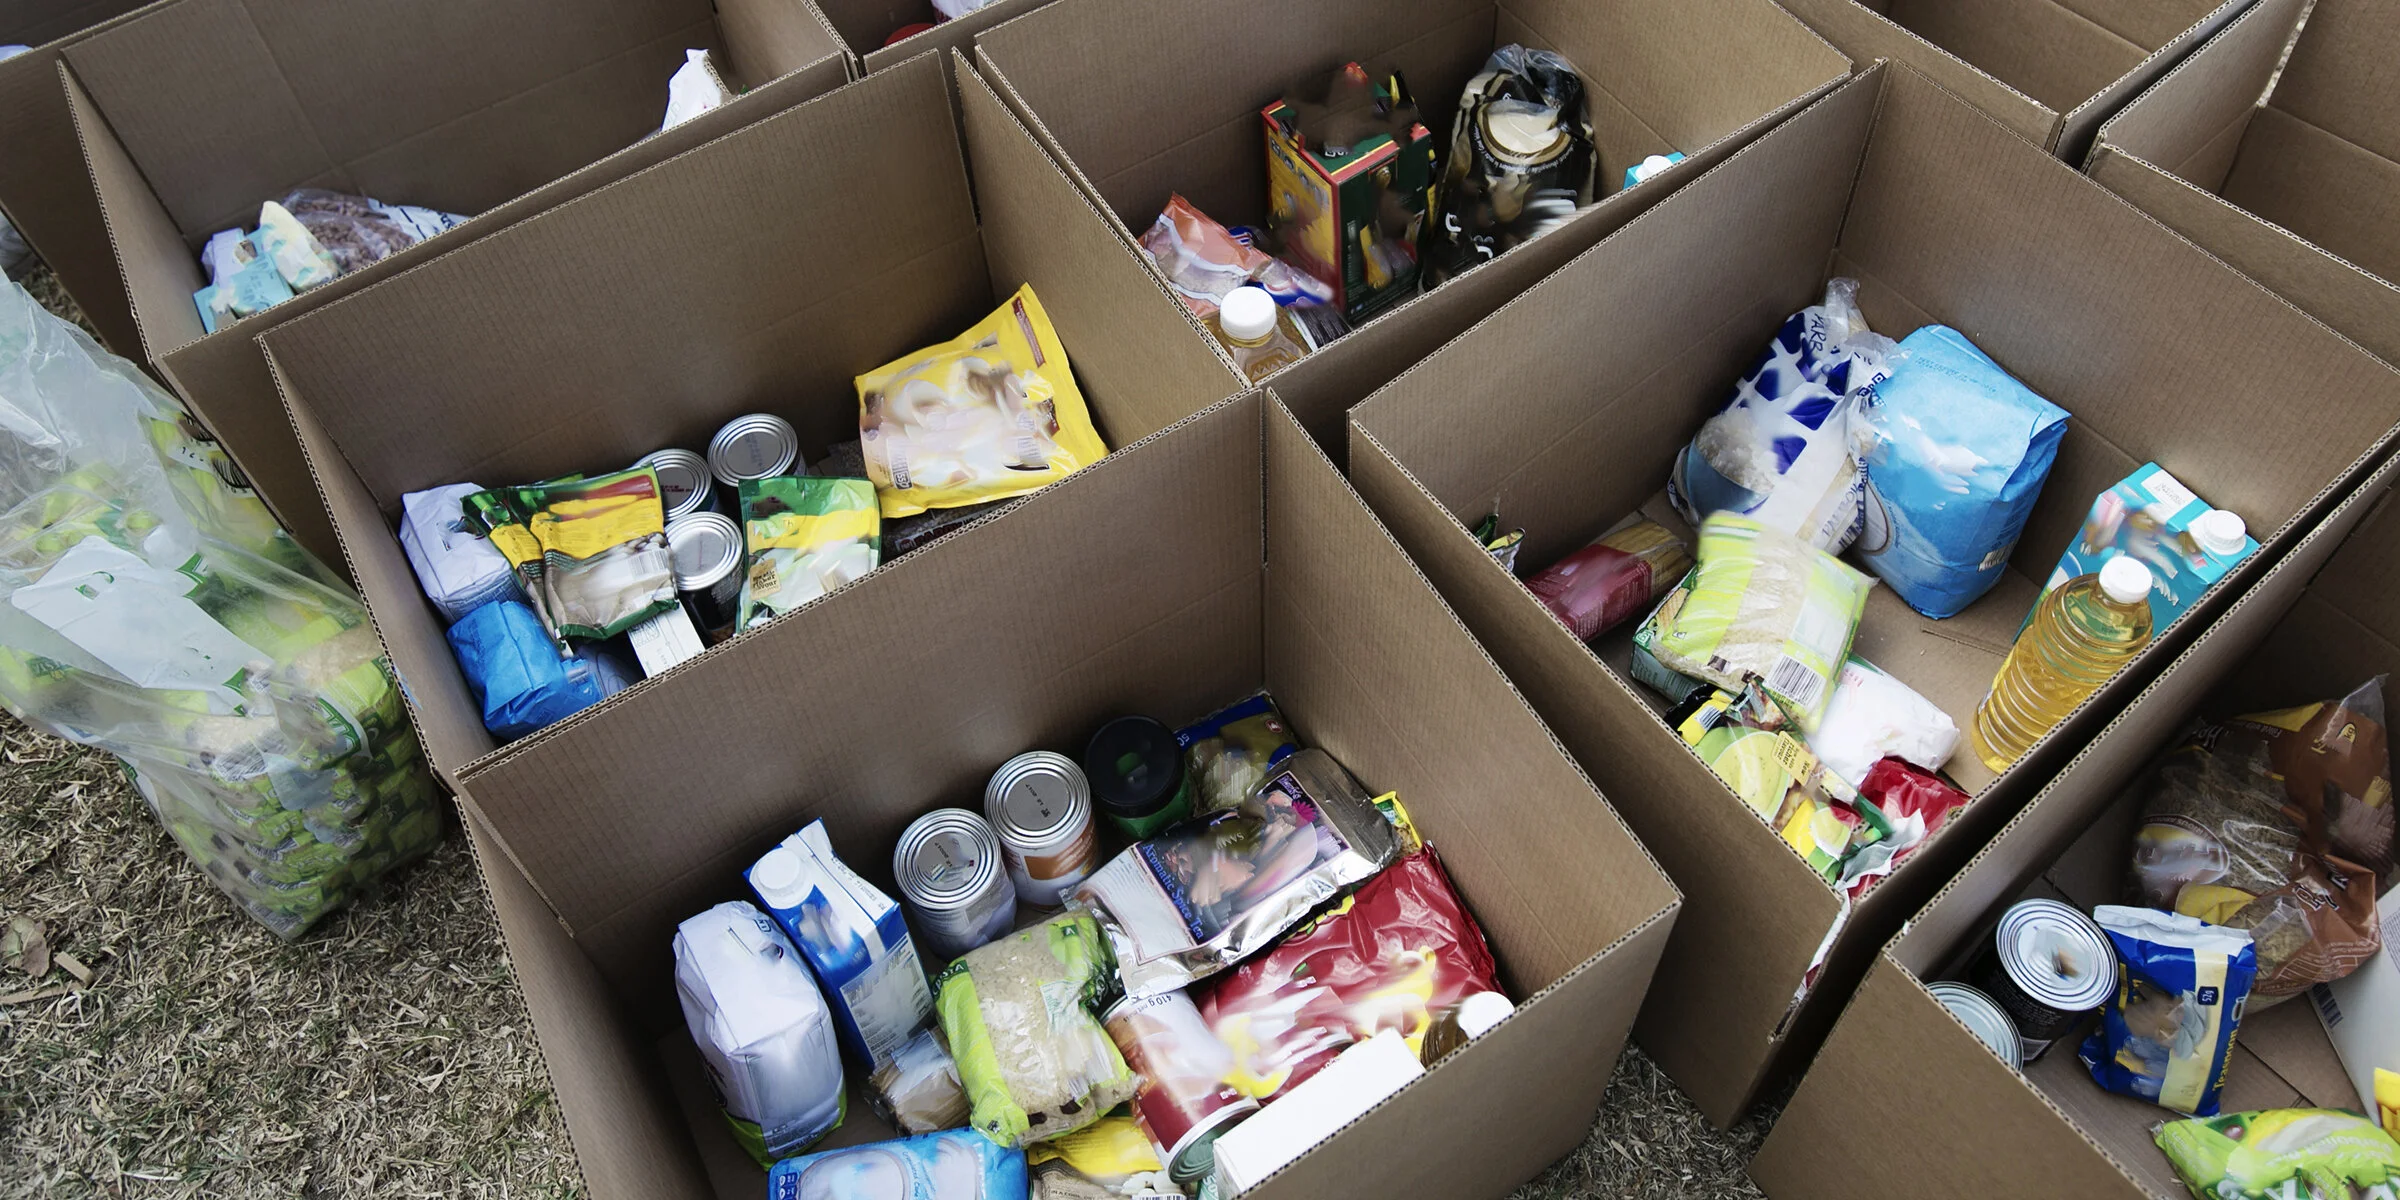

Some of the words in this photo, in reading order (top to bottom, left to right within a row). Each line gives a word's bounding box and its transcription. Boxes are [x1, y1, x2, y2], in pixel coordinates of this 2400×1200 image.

[1143, 844, 1174, 890] Aromatic
[1171, 886, 1192, 920] Spice
[1190, 917, 1203, 939] Tea
[1156, 995, 1172, 1005] 410
